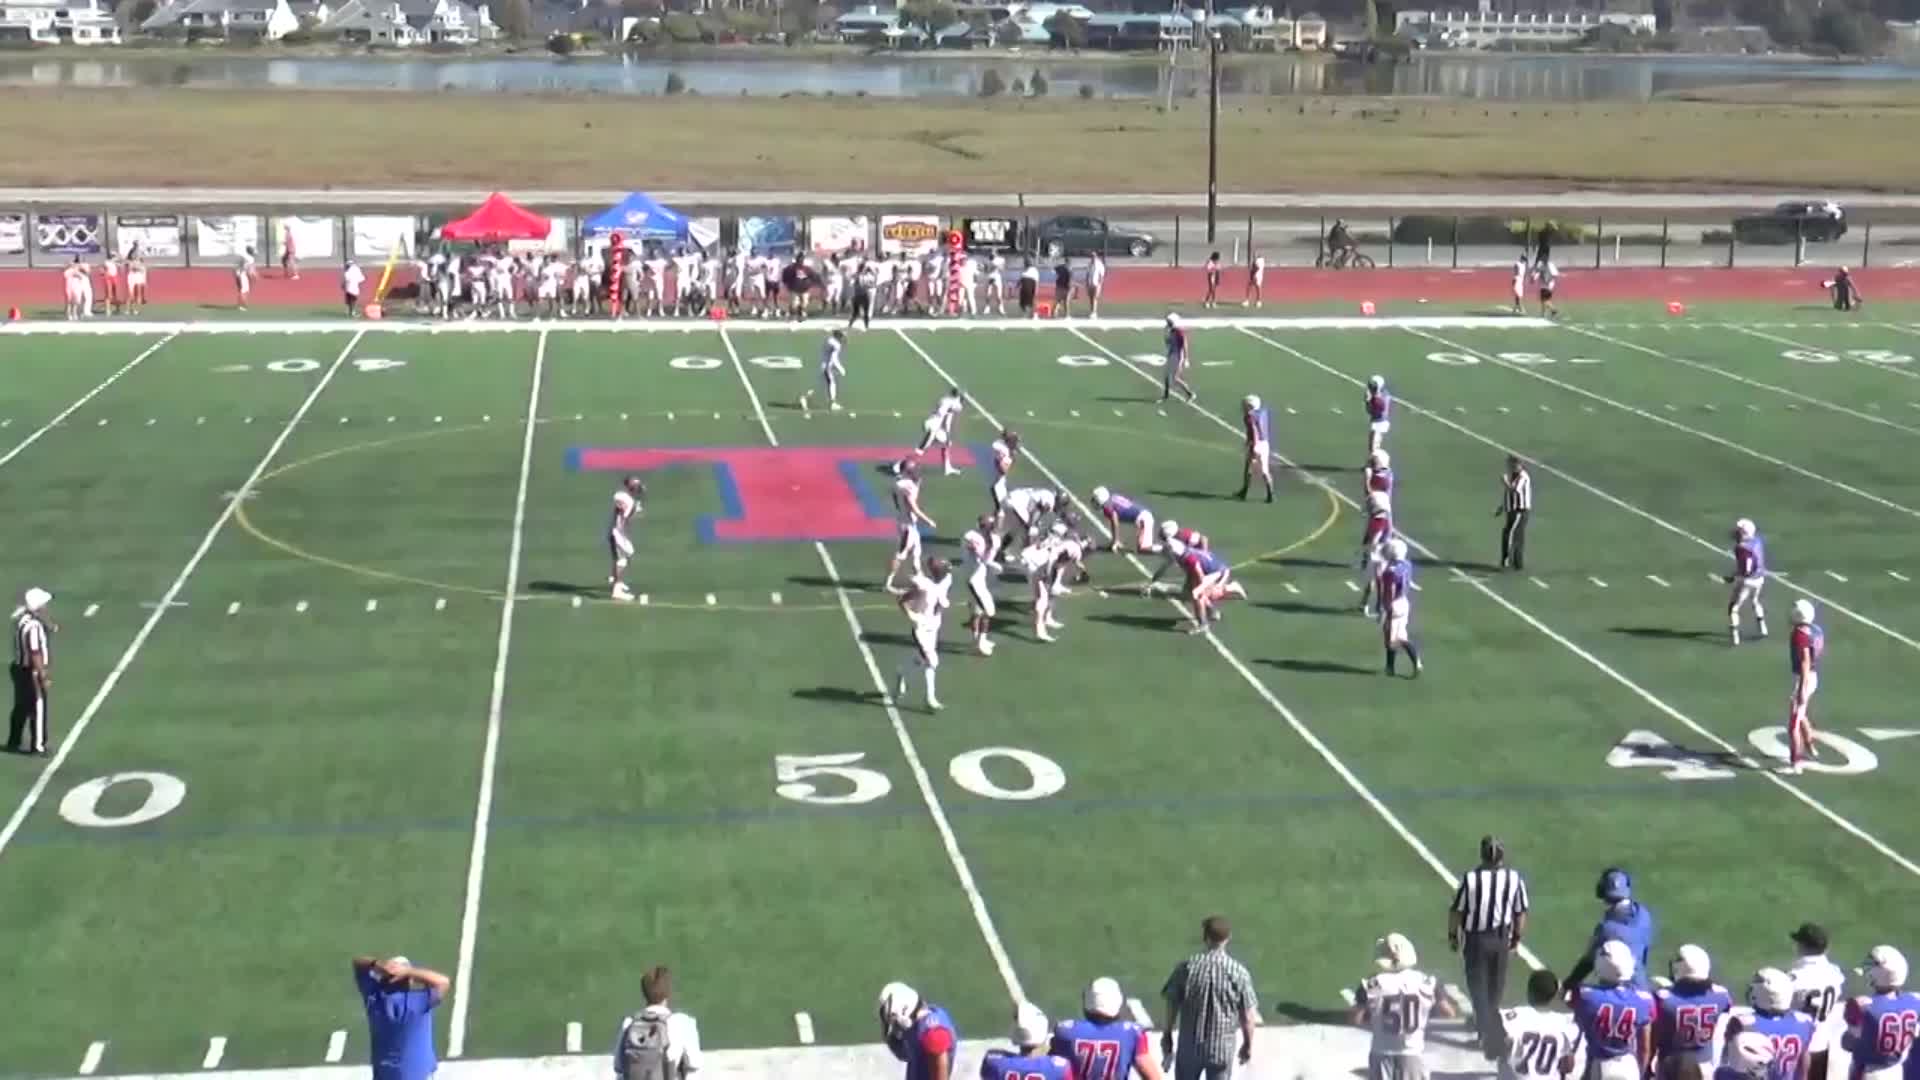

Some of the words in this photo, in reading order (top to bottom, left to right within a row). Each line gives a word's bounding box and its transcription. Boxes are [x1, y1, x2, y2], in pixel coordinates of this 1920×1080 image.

[1594, 1002, 1637, 1042] 44
[1676, 1003, 1717, 1042] 55
[1878, 1010, 1918, 1057] 66
[1074, 1039, 1121, 1080] 77
[1520, 1031, 1558, 1076] 70
